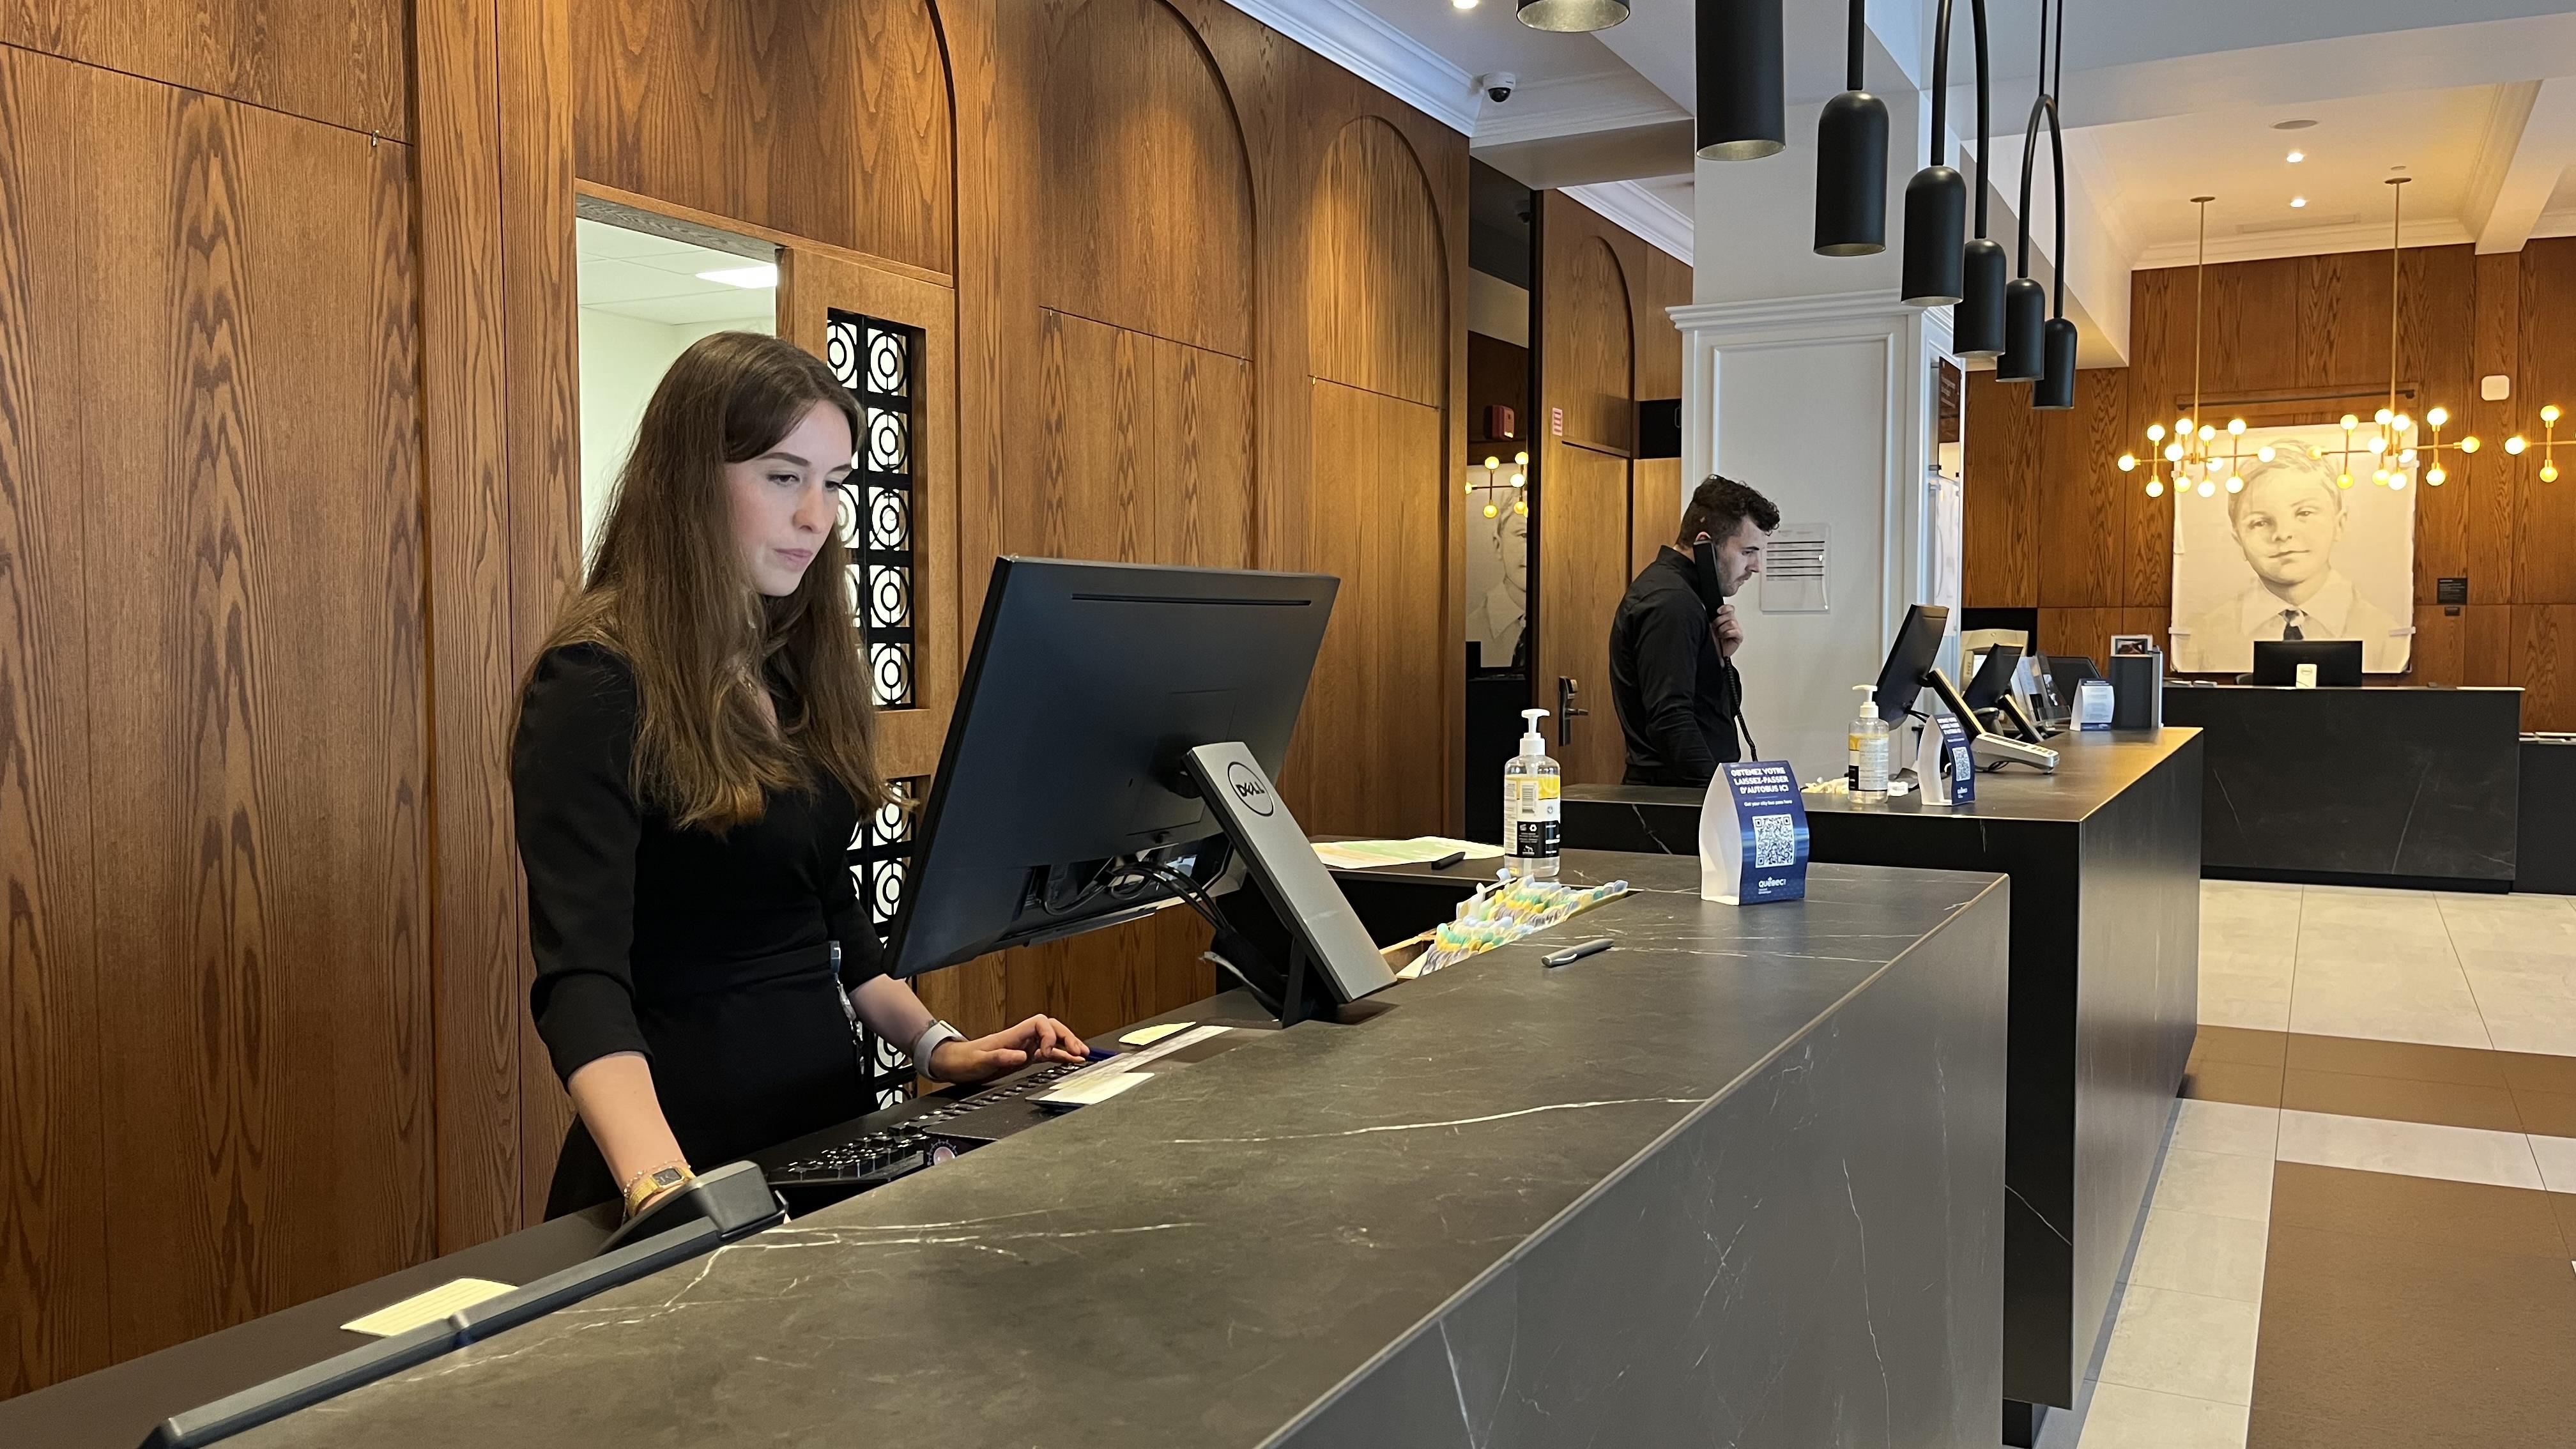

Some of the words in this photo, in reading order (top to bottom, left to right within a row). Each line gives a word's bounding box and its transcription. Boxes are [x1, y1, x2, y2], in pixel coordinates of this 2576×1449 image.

[1730, 769, 1762, 777] OBTENEZ
[1733, 776, 1789, 785] LAISSEZ-PASSER
[1235, 781, 1265, 797] DELL
[1740, 785, 1779, 794] D'AUTOBUS
[1779, 784, 1789, 792] ICI
